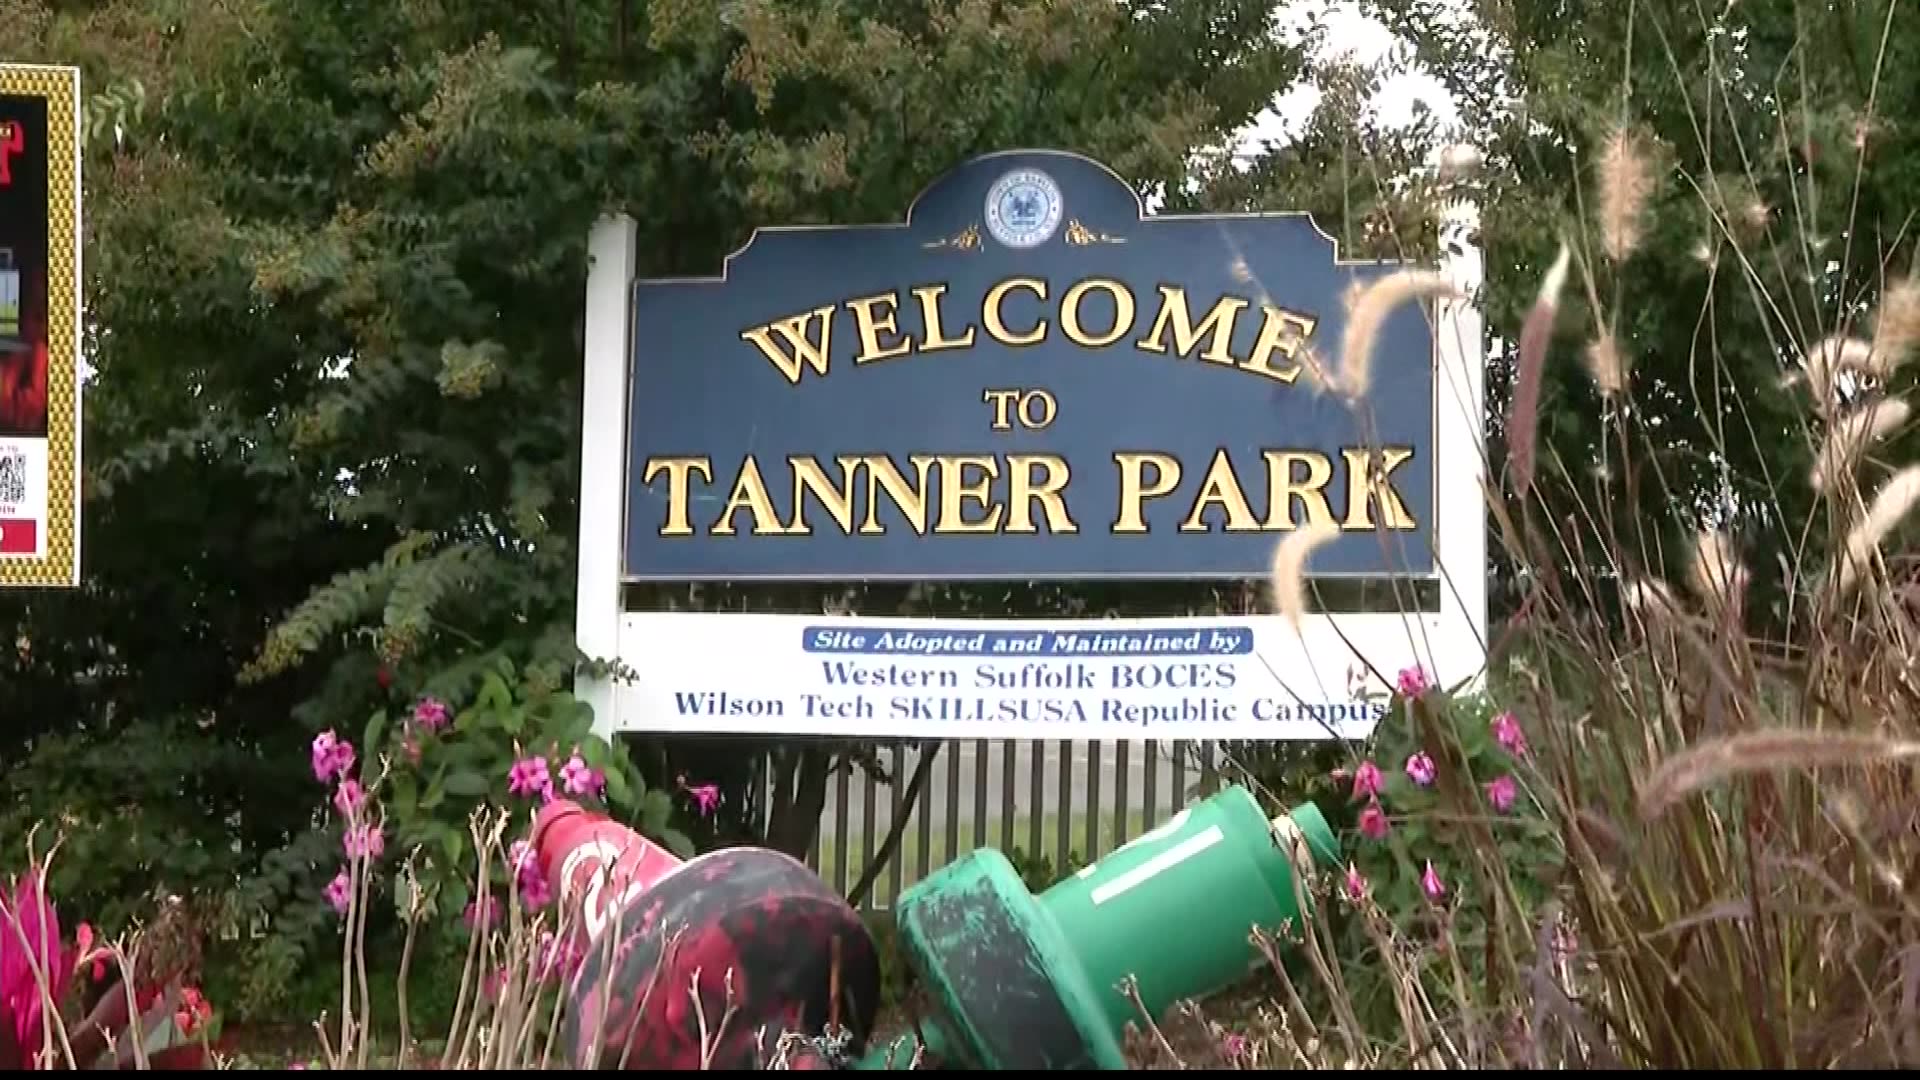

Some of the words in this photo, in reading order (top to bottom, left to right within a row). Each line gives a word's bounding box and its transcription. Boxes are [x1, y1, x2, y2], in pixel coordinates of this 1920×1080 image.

[739, 277, 1318, 386] WELCOME
[983, 388, 1058, 431] TO
[643, 453, 1080, 538] TANNER
[1110, 447, 1416, 534] PARK
[813, 630, 866, 650] Site
[873, 631, 986, 653] Adopted
[992, 633, 1042, 653] and
[1051, 632, 1201, 654] Maintained
[1209, 630, 1242, 654] by
[821, 660, 958, 688] Western
[974, 662, 1096, 690] Suffolk
[1111, 662, 1237, 689] BOCES
[674, 691, 785, 716] Wilson
[799, 693, 874, 720] Tech
[889, 696, 1087, 723] SKILLSUSA
[1101, 697, 1238, 727] Republic
[1251, 698, 1385, 726] Campus
